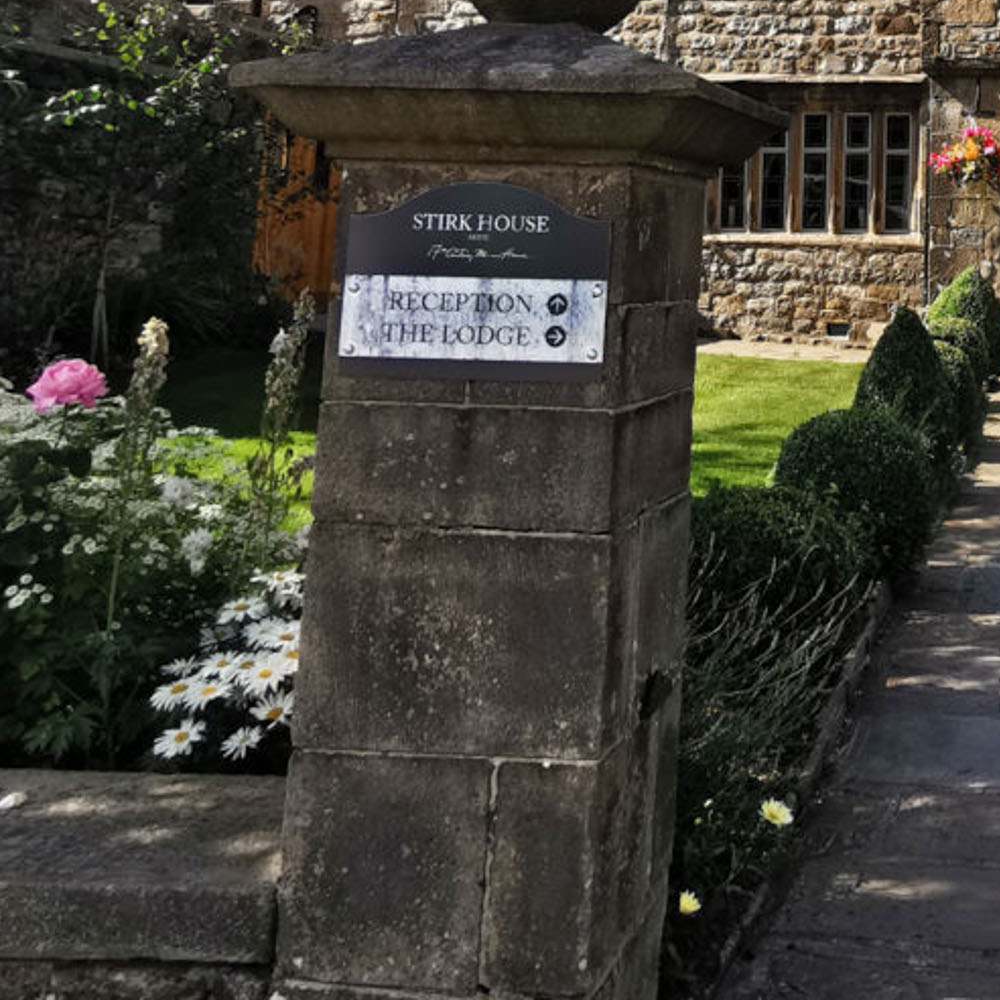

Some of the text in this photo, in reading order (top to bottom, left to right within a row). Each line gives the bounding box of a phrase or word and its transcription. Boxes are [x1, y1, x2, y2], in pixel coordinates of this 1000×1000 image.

[412, 213, 550, 233] STIRK HOUSE
[389, 290, 533, 313] RECEPTION
[381, 322, 531, 346] THE LODGE
